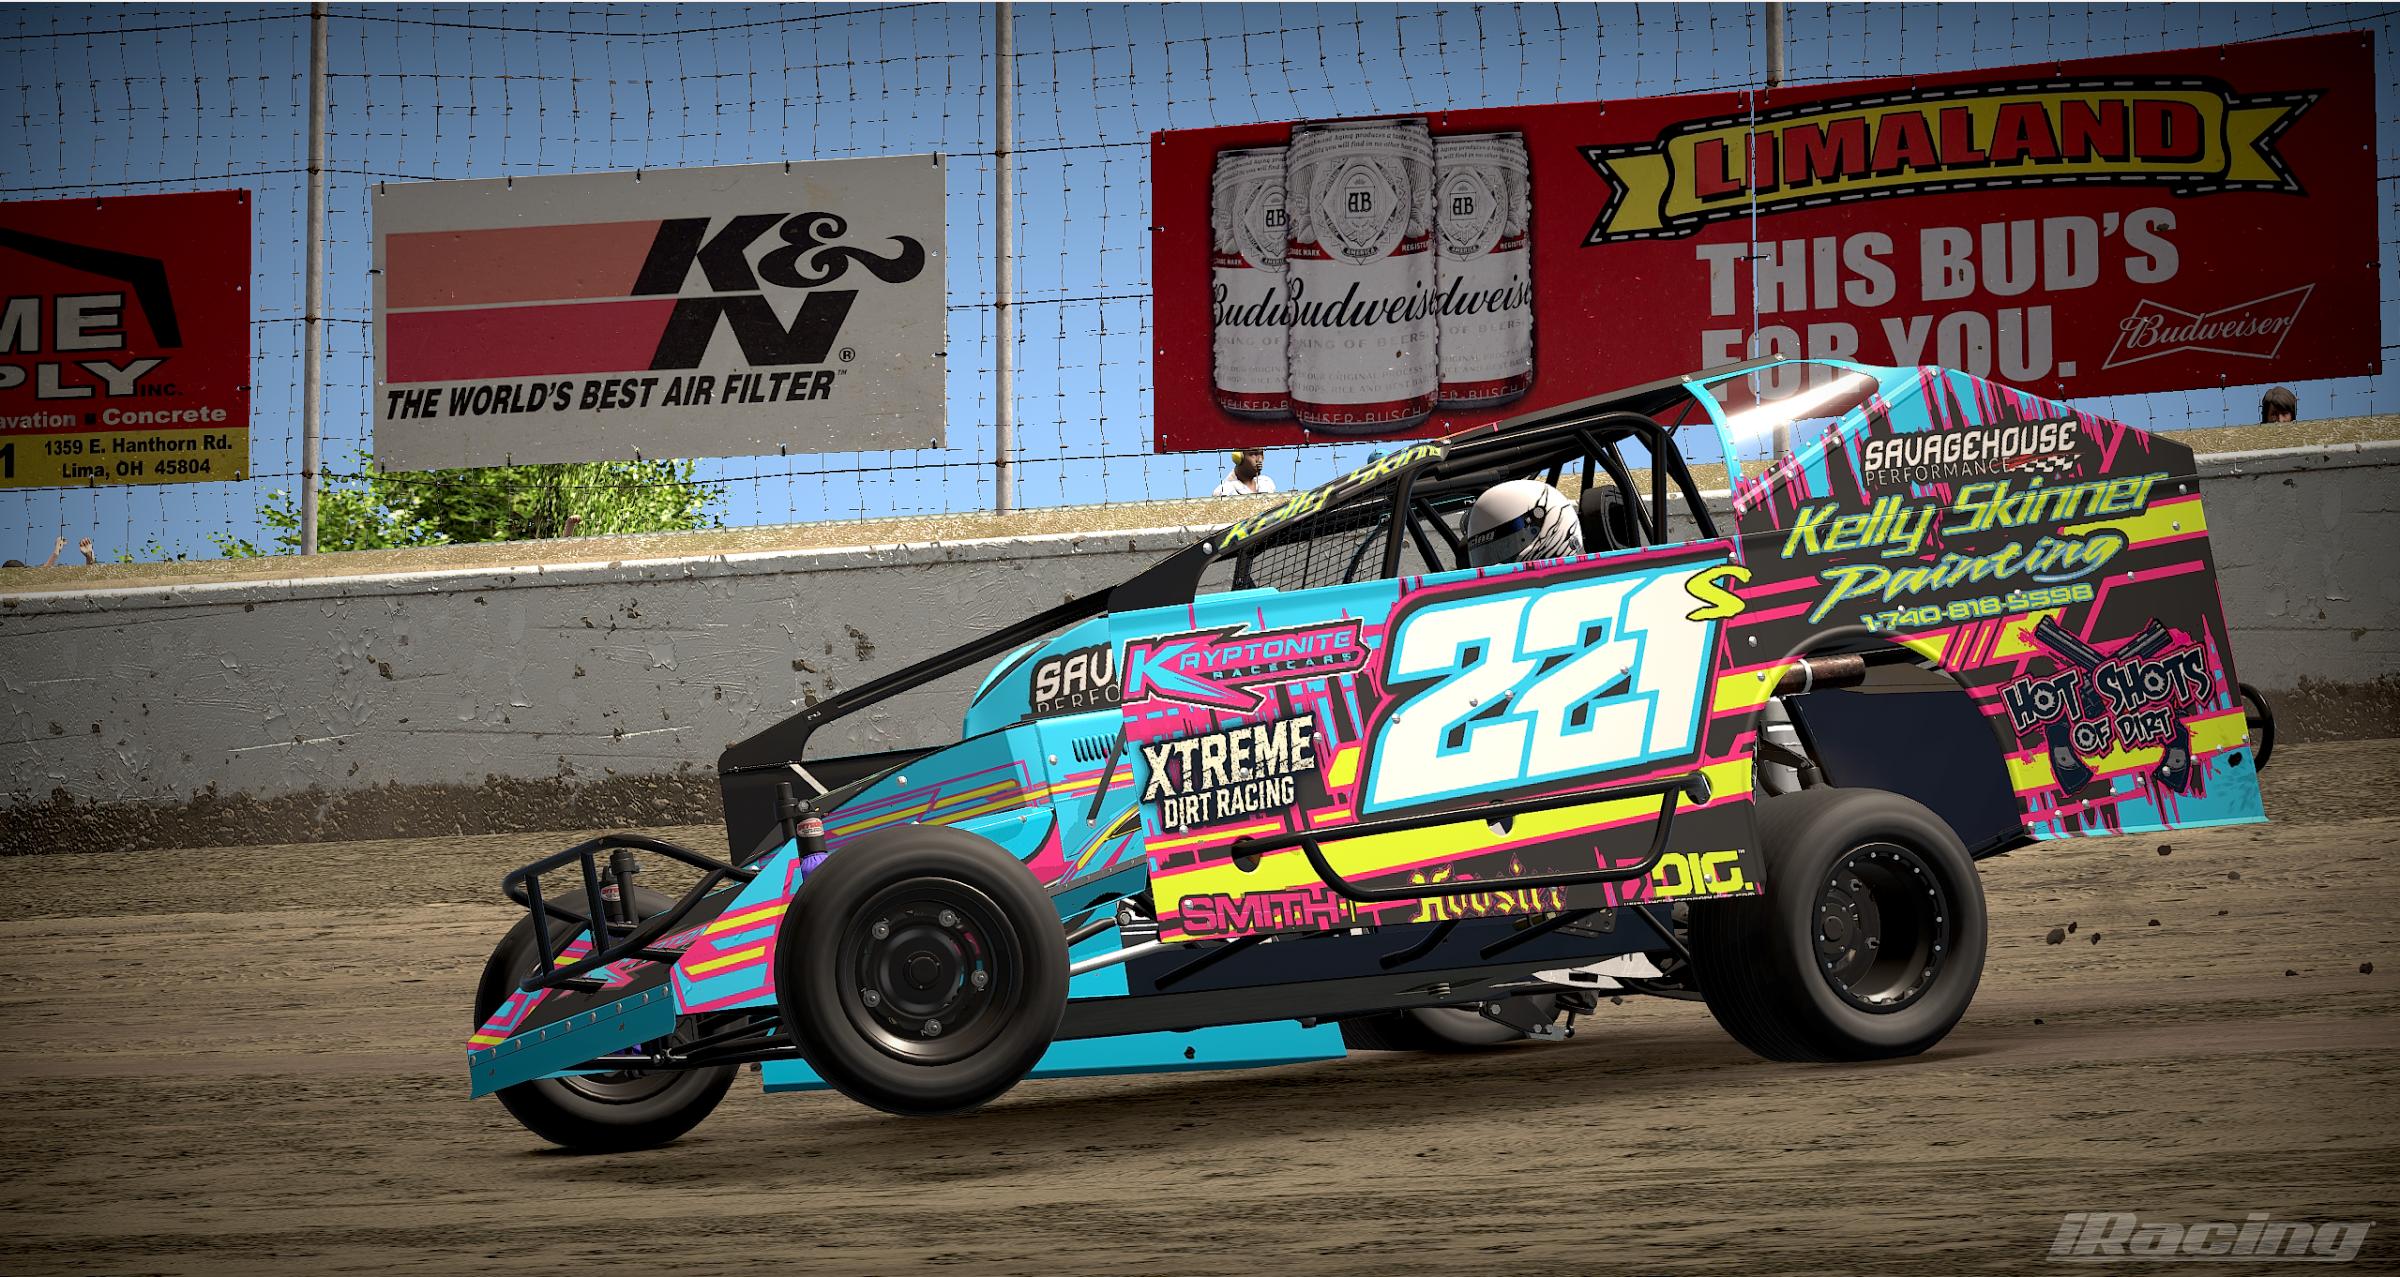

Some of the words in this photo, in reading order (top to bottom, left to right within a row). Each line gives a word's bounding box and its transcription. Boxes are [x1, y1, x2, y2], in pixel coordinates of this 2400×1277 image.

[1693, 99, 2204, 201] LIMALAND
[1265, 209, 1286, 227] AB
[1348, 192, 1373, 213] AB
[1453, 197, 1474, 215] AB
[1696, 224, 1896, 316] THIS
[1921, 207, 2179, 301] BUD'S
[1343, 338, 1368, 349] OF
[1702, 321, 1860, 402] FOR
[1880, 305, 2077, 383] YOU.
[2120, 312, 2293, 348] Budweiser
[141, 384, 183, 397] INC.
[382, 388, 443, 420] THE
[448, 381, 574, 417] WORLD'S
[579, 378, 658, 412] BEST
[661, 375, 715, 407] AIR
[721, 370, 835, 404] FILTER
[102, 406, 227, 426] Concrete
[45, 439, 83, 456] 1359
[90, 438, 106, 454] E.
[113, 435, 197, 454] Hanthorn
[203, 434, 233, 450] Rd.
[1864, 421, 2077, 472] SAVAGEHOUSE
[62, 463, 110, 481] Lima,
[116, 460, 143, 477] OH
[155, 458, 211, 476] 45804
[1866, 456, 2012, 487] PERFORMANCE
[1779, 494, 1948, 560] Kelly
[1942, 472, 2169, 537] Skinner
[1809, 531, 2125, 625] Painting
[1861, 582, 2094, 634] 1-740-818-5598
[1128, 629, 1353, 698] KRYPTONITE
[1212, 653, 1352, 680] RACECARS
[1365, 561, 1724, 813] 221
[2001, 669, 2081, 732] HOT
[2094, 646, 2211, 716] SHOTS
[2072, 718, 2112, 752] OF
[2115, 706, 2173, 744] DIRT
[1142, 713, 1317, 802] XTREME
[1163, 792, 1209, 828] DIRT
[1216, 776, 1295, 819] RACING
[1181, 889, 1341, 933] SMITH
